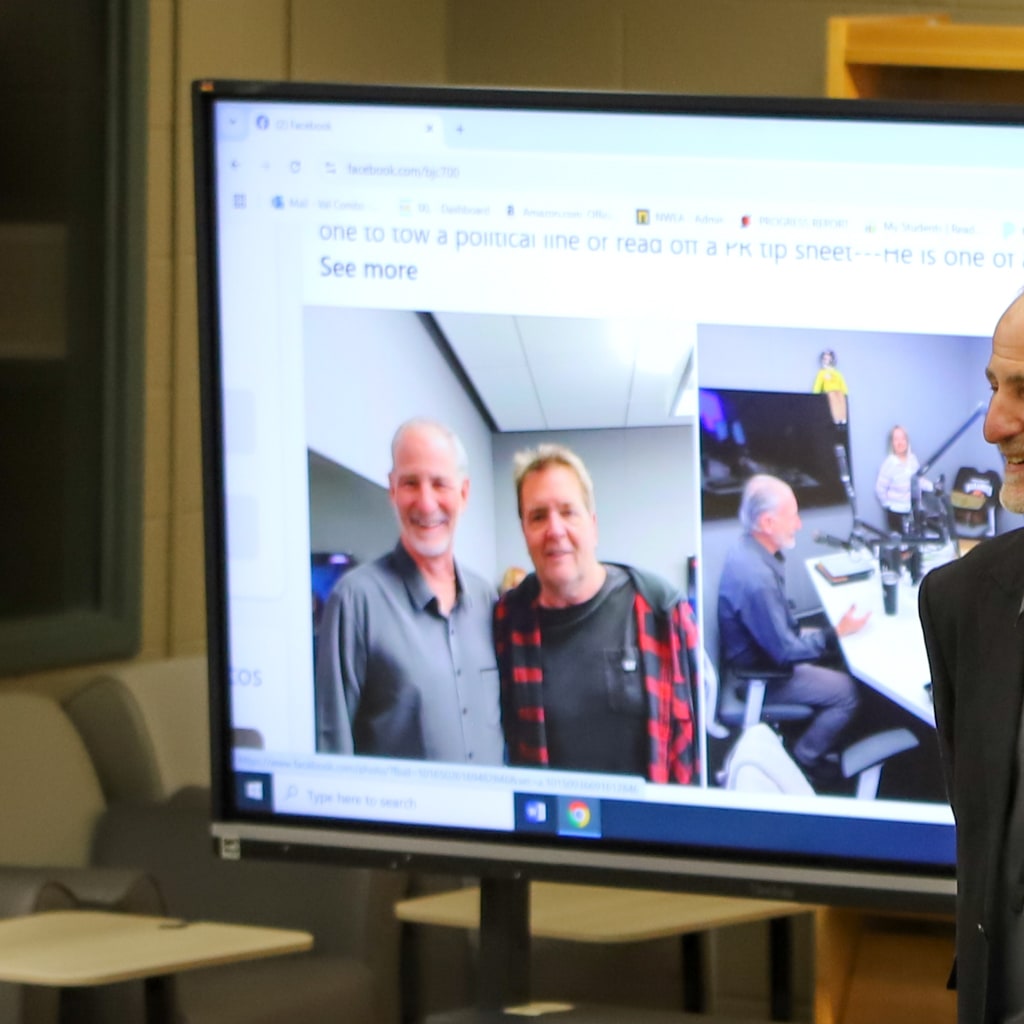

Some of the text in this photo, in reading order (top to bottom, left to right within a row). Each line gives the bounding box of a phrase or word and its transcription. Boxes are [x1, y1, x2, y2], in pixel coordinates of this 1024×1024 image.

[319, 224, 357, 242] one
[364, 225, 386, 244] to
[436, 230, 448, 246] a
[587, 234, 608, 252] or
[706, 240, 718, 256] a
[944, 251, 985, 268] one
[319, 255, 418, 281] See more
